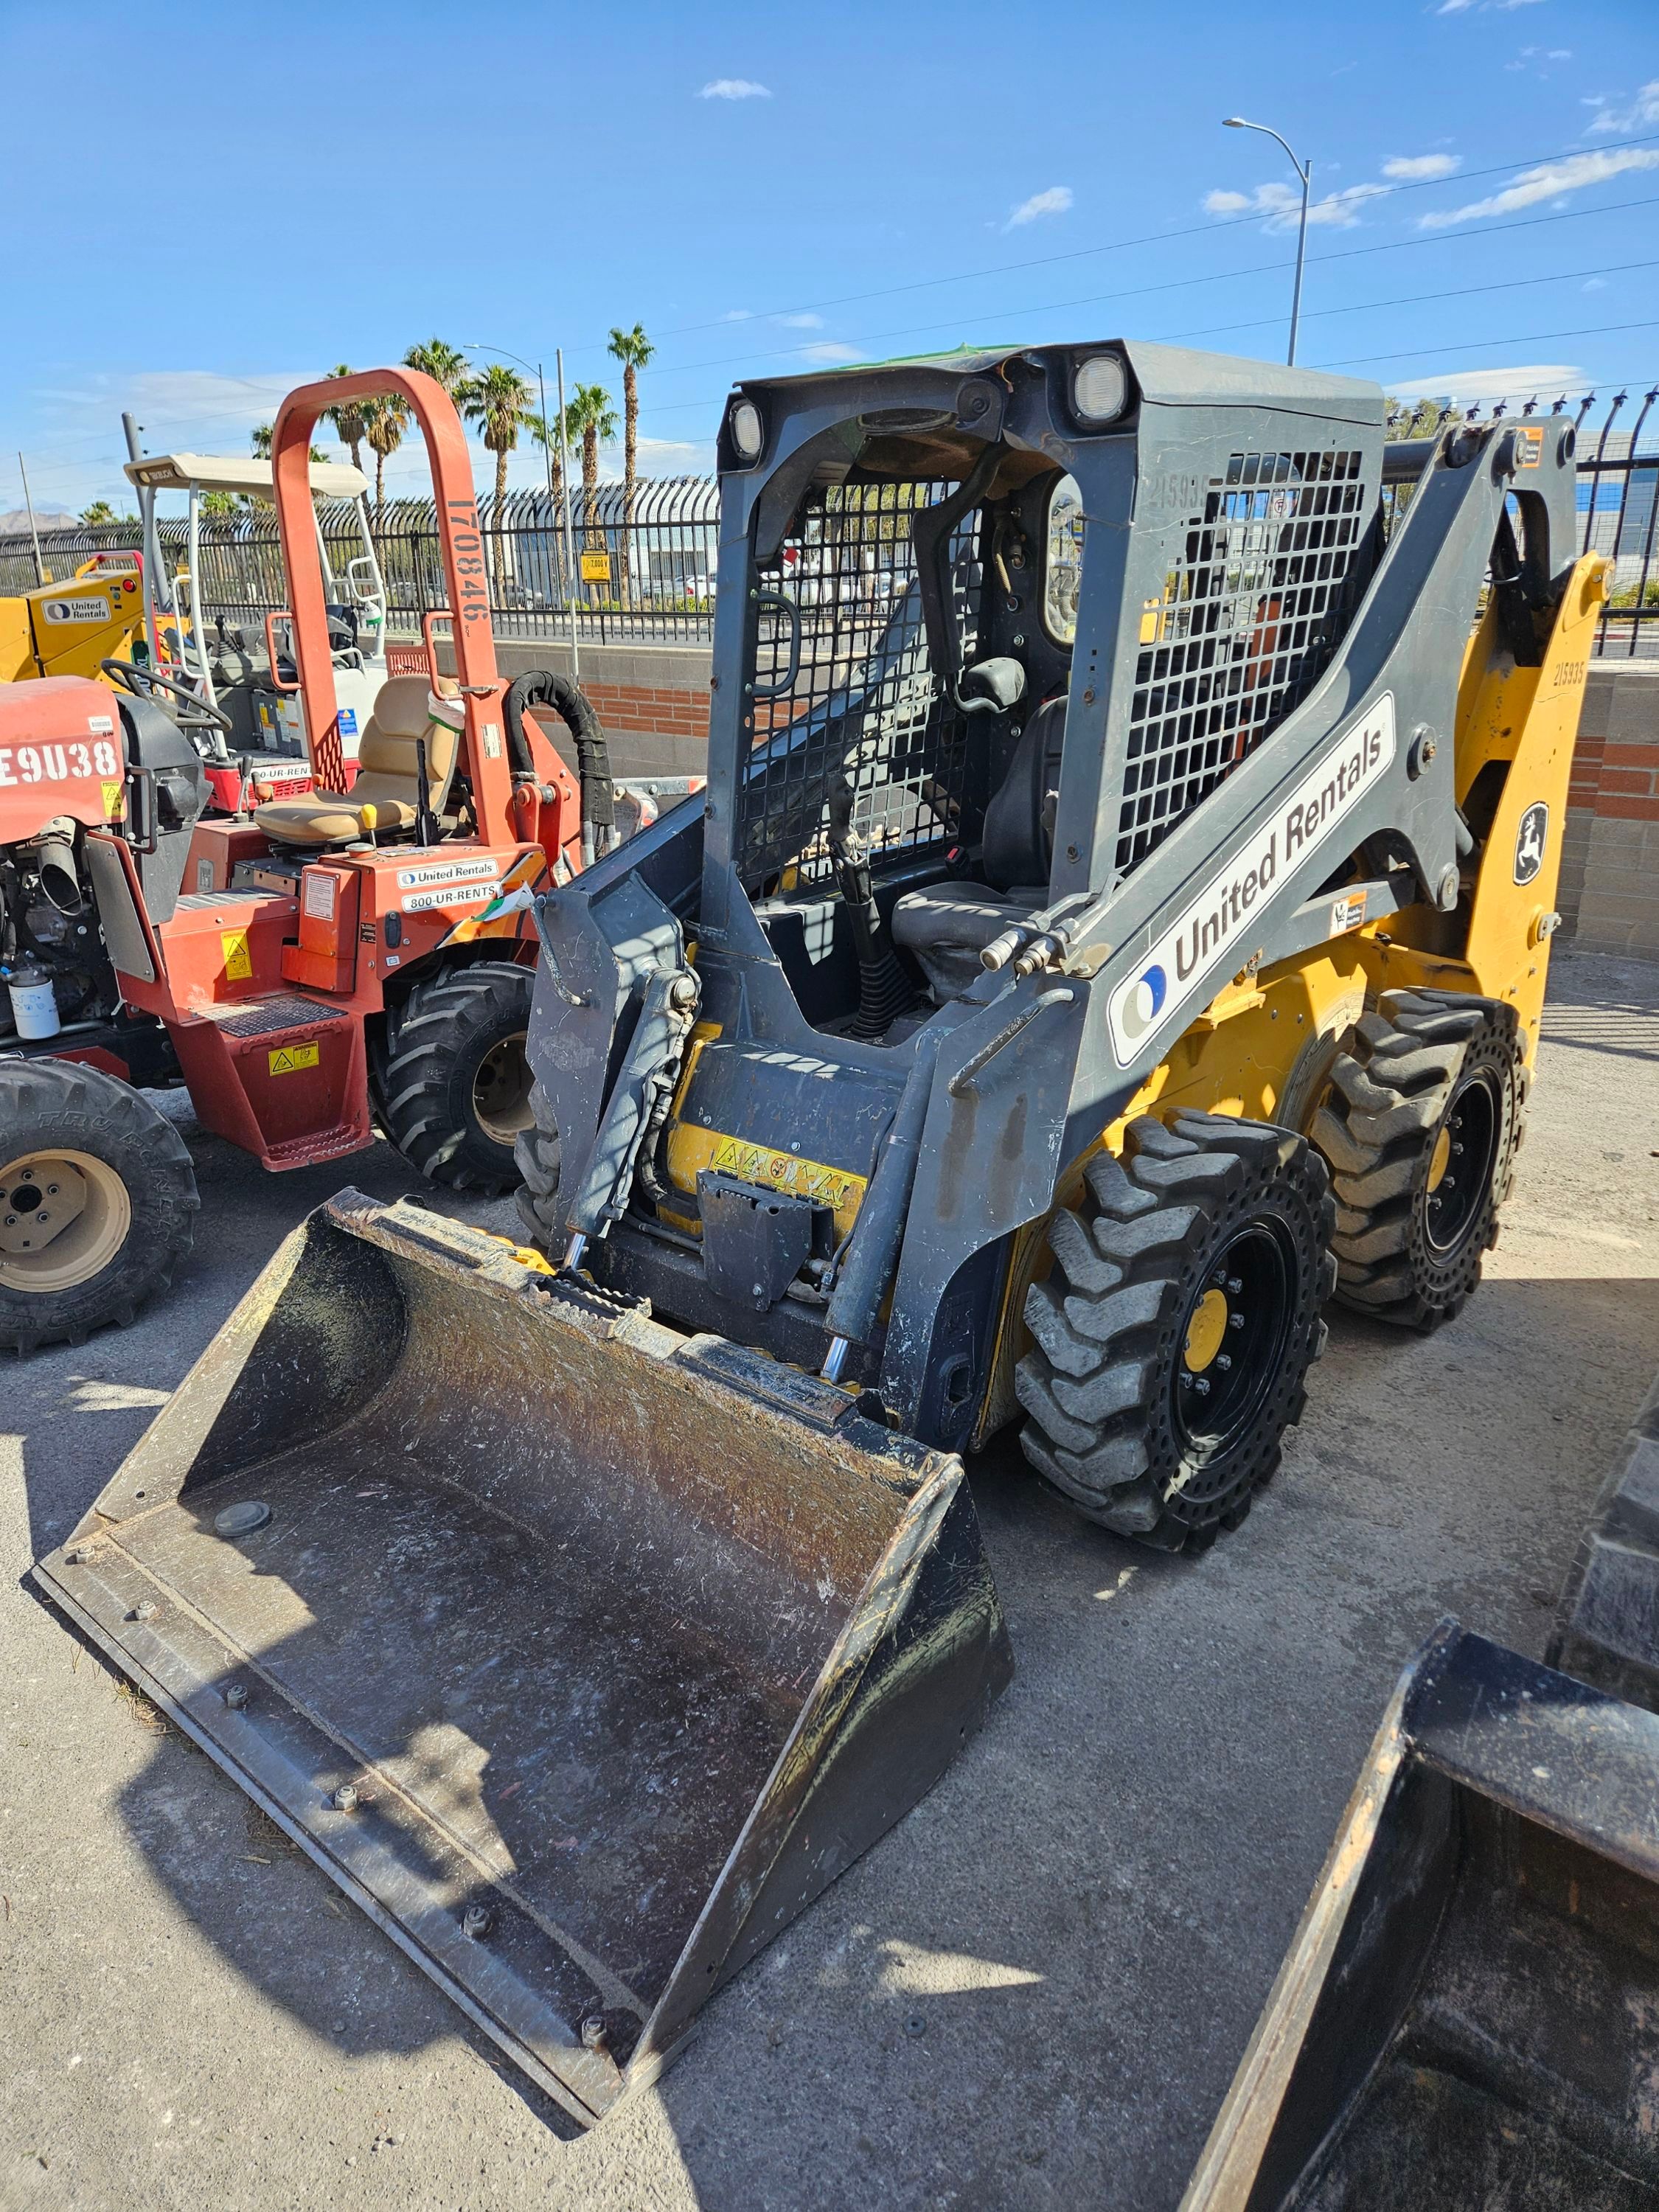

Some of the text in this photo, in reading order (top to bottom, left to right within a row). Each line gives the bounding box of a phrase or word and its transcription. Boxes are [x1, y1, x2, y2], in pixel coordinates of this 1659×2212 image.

[448, 501, 488, 621] 170846
[72, 601, 100, 611] United
[74, 610, 106, 619] Rentals
[1554, 661, 1585, 686] 215935
[1176, 728, 1381, 982] United Rentals
[418, 863, 493, 882] United Rentals
[411, 886, 495, 908] 800-UR-RENTS
